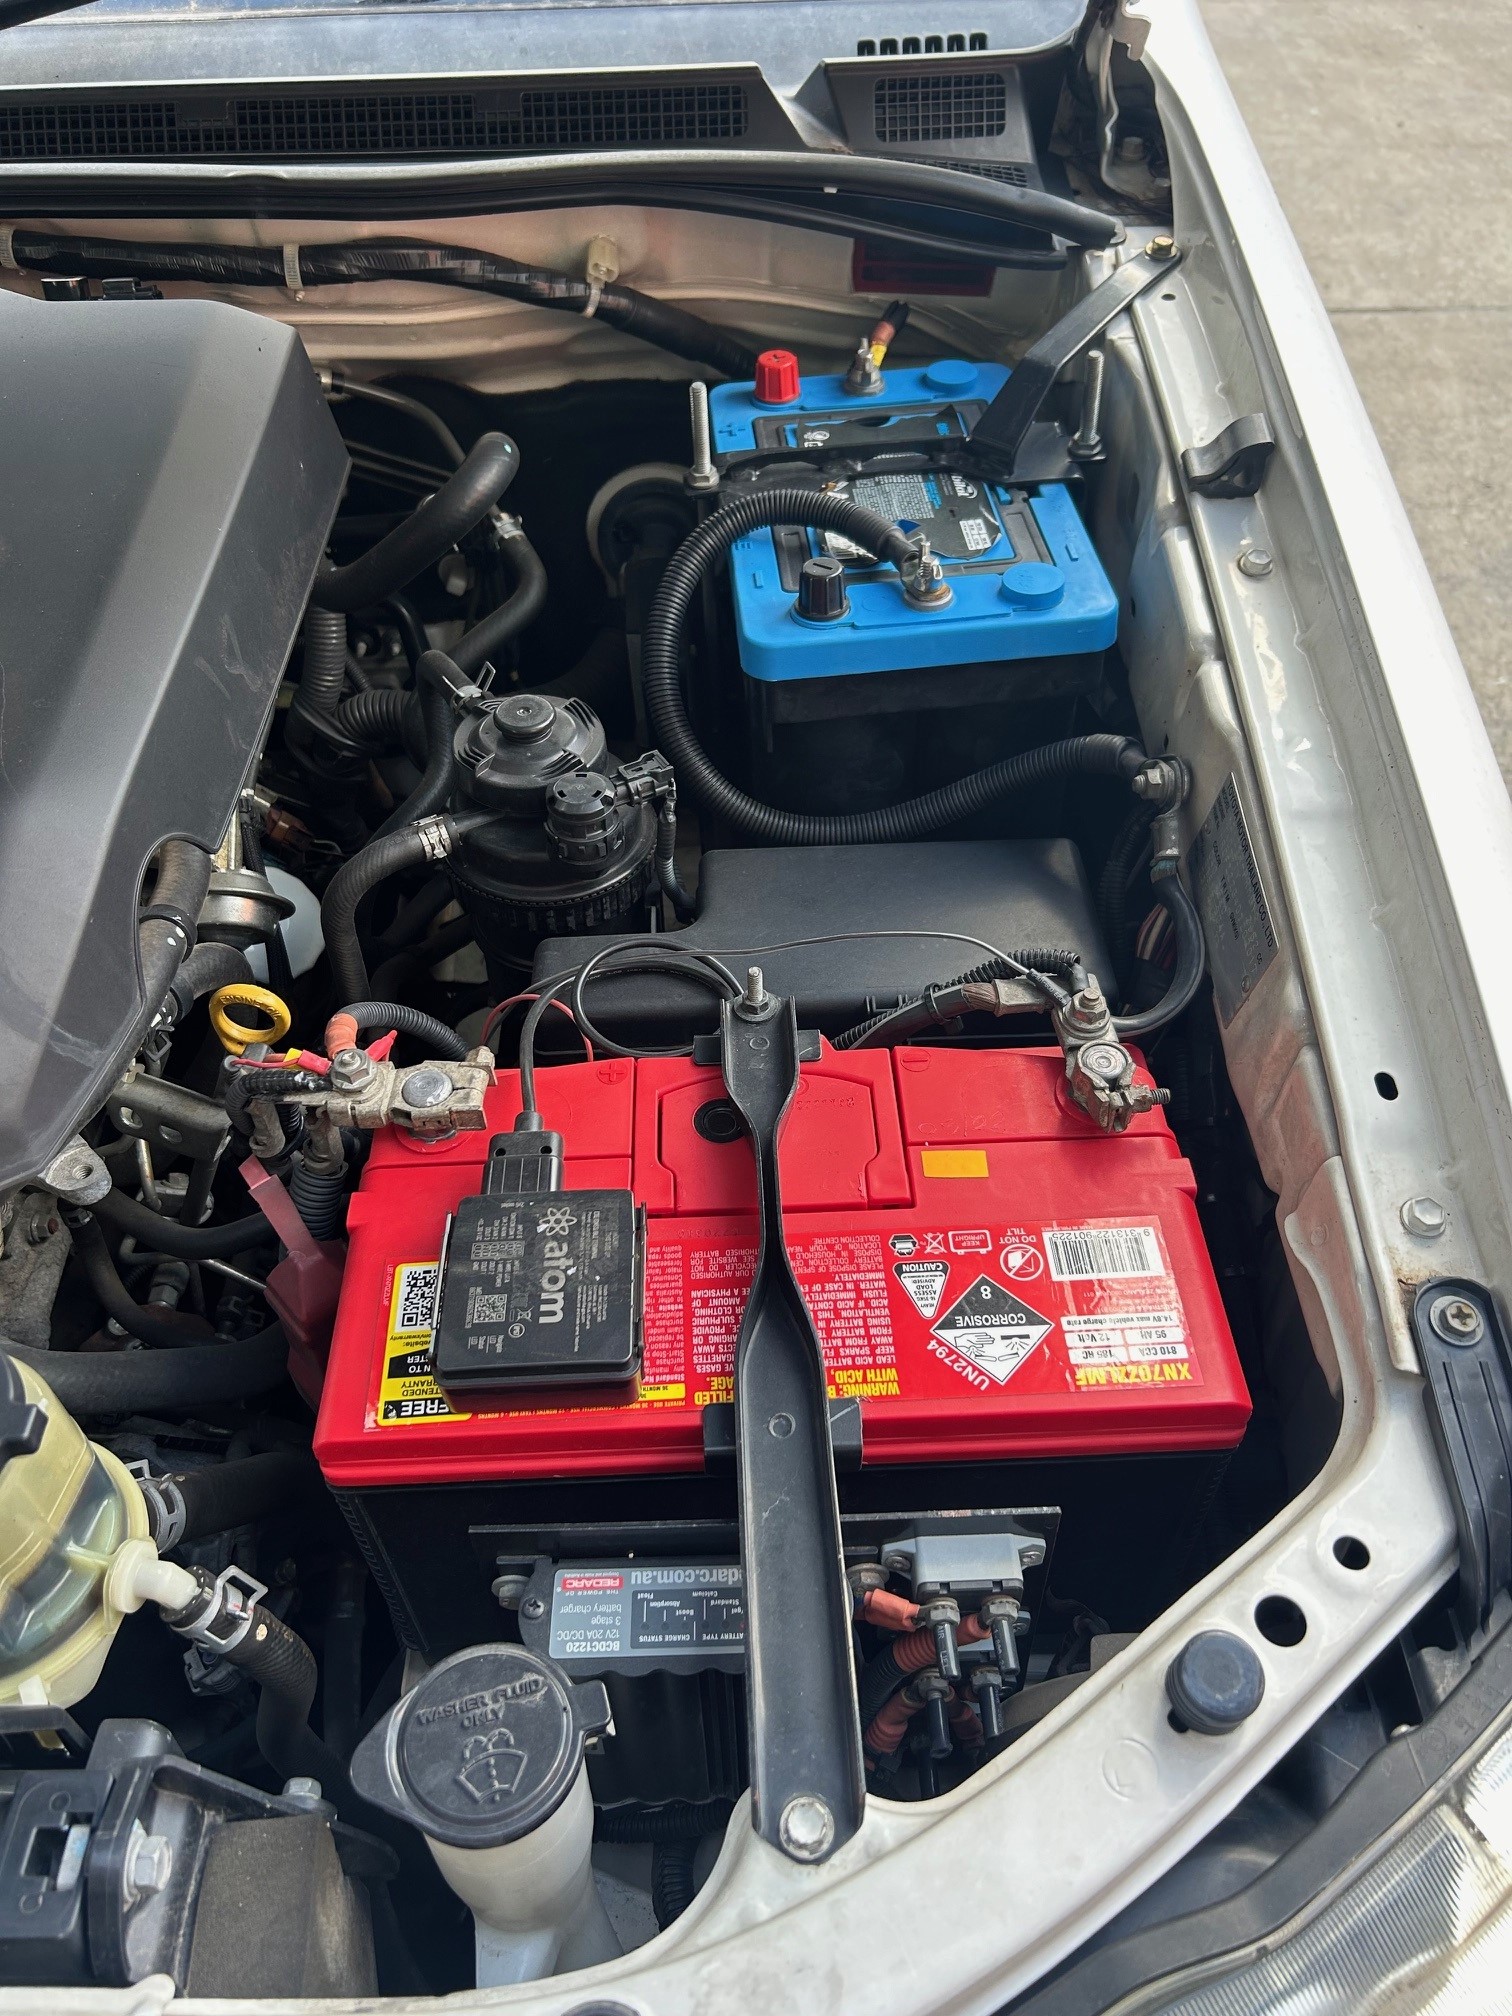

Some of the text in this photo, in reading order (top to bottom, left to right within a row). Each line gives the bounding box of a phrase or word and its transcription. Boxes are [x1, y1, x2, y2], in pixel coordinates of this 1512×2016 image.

[1227, 783, 1240, 823] TOYOTA
[1235, 821, 1249, 853] MOTOR
[1244, 852, 1261, 903] THAILAND
[220, 995, 262, 1007] ENGINE
[1052, 1228, 1150, 1241] 9 313122 901225
[812, 1236, 838, 1244] CENTRE.
[662, 1245, 682, 1253] quality
[849, 1241, 881, 1249] LOCATION
[690, 1250, 719, 1258] BATTERY
[796, 1251, 836, 1259] HOUSEHOLD
[648, 1260, 682, 1268] foreseeable
[859, 1263, 883, 1271] PLEASE
[902, 1263, 942, 1271] CAUTION
[794, 1266, 815, 1274] SPENT
[691, 1271, 732, 1279] AUTHORISED
[832, 1271, 884, 1280] IMMEDIATELY.
[538, 1240, 574, 1324] atom
[650, 1280, 683, 1288] guarantees
[857, 1280, 886, 1288] WATER.
[691, 1288, 730, 1298] PHYSICIAN
[980, 1285, 992, 1299] 8
[709, 1289, 887, 1306] FLUSH IMMEDIATELY AMOUNT
[837, 1300, 854, 1308] ACID
[868, 1299, 888, 1307] ACID.
[646, 1311, 683, 1319] adjudication
[692, 1307, 732, 1315] CLOTHING,
[692, 1308, 890, 1325] VENTILATION. THIS SULPHURIC
[955, 1313, 1026, 1327] CORROSIVE
[1108, 1316, 1134, 1324] vehicle
[1152, 1314, 1173, 1322] 14.8V
[656, 1318, 683, 1326] purchase
[818, 1320, 826, 1328] IN
[830, 1318, 863, 1326] BATTERY
[867, 1317, 891, 1325] USING
[1083, 1318, 1106, 1326] charge
[692, 1326, 725, 1334] PROVIDE
[831, 1328, 864, 1336] BATTERY
[869, 1326, 892, 1335] FROM
[649, 1334, 674, 1342] replaced
[709, 1334, 737, 1343] ARGING
[1077, 1333, 1096, 1342] Volt
[1155, 1330, 1166, 1339] 95
[692, 1336, 703, 1344] OR
[845, 1337, 867, 1345] FROM
[871, 1336, 893, 1344] AWAY
[693, 1345, 715, 1353] AWAY
[840, 1346, 870, 1355] SPARKS
[875, 1346, 894, 1354] KEEP
[1139, 1346, 1177, 1356] 810 CCA
[652, 1349, 684, 1358] Start-Stop
[655, 1357, 684, 1365] purchase
[693, 1354, 734, 1363] IGARETTES
[855, 1356, 873, 1364] ACID
[876, 1355, 896, 1363] LEAD
[694, 1364, 721, 1373] GASES.
[926, 1339, 990, 1391] UN2794
[408, 1365, 422, 1374] TO
[655, 1374, 684, 1382] Standard
[706, 1368, 898, 1390] WITH ACID, AGE.
[839, 1382, 900, 1397] WARNING:
[694, 1390, 734, 1405] FILLED
[401, 1400, 449, 1416] FREE
[631, 1569, 741, 1585] darc.com.au
[566, 1578, 619, 1588] REDARC
[710, 1598, 739, 1606] Standard
[560, 1603, 621, 1614] battery charger
[591, 1615, 621, 1625] 3 stage
[557, 1629, 619, 1640] 12V 20A DC/DC
[721, 1632, 744, 1640] ATTERY
[566, 1641, 619, 1652] BCDC1220
[416, 1677, 541, 1725] WASHER FLUID
[461, 1705, 503, 1729] ONLY
